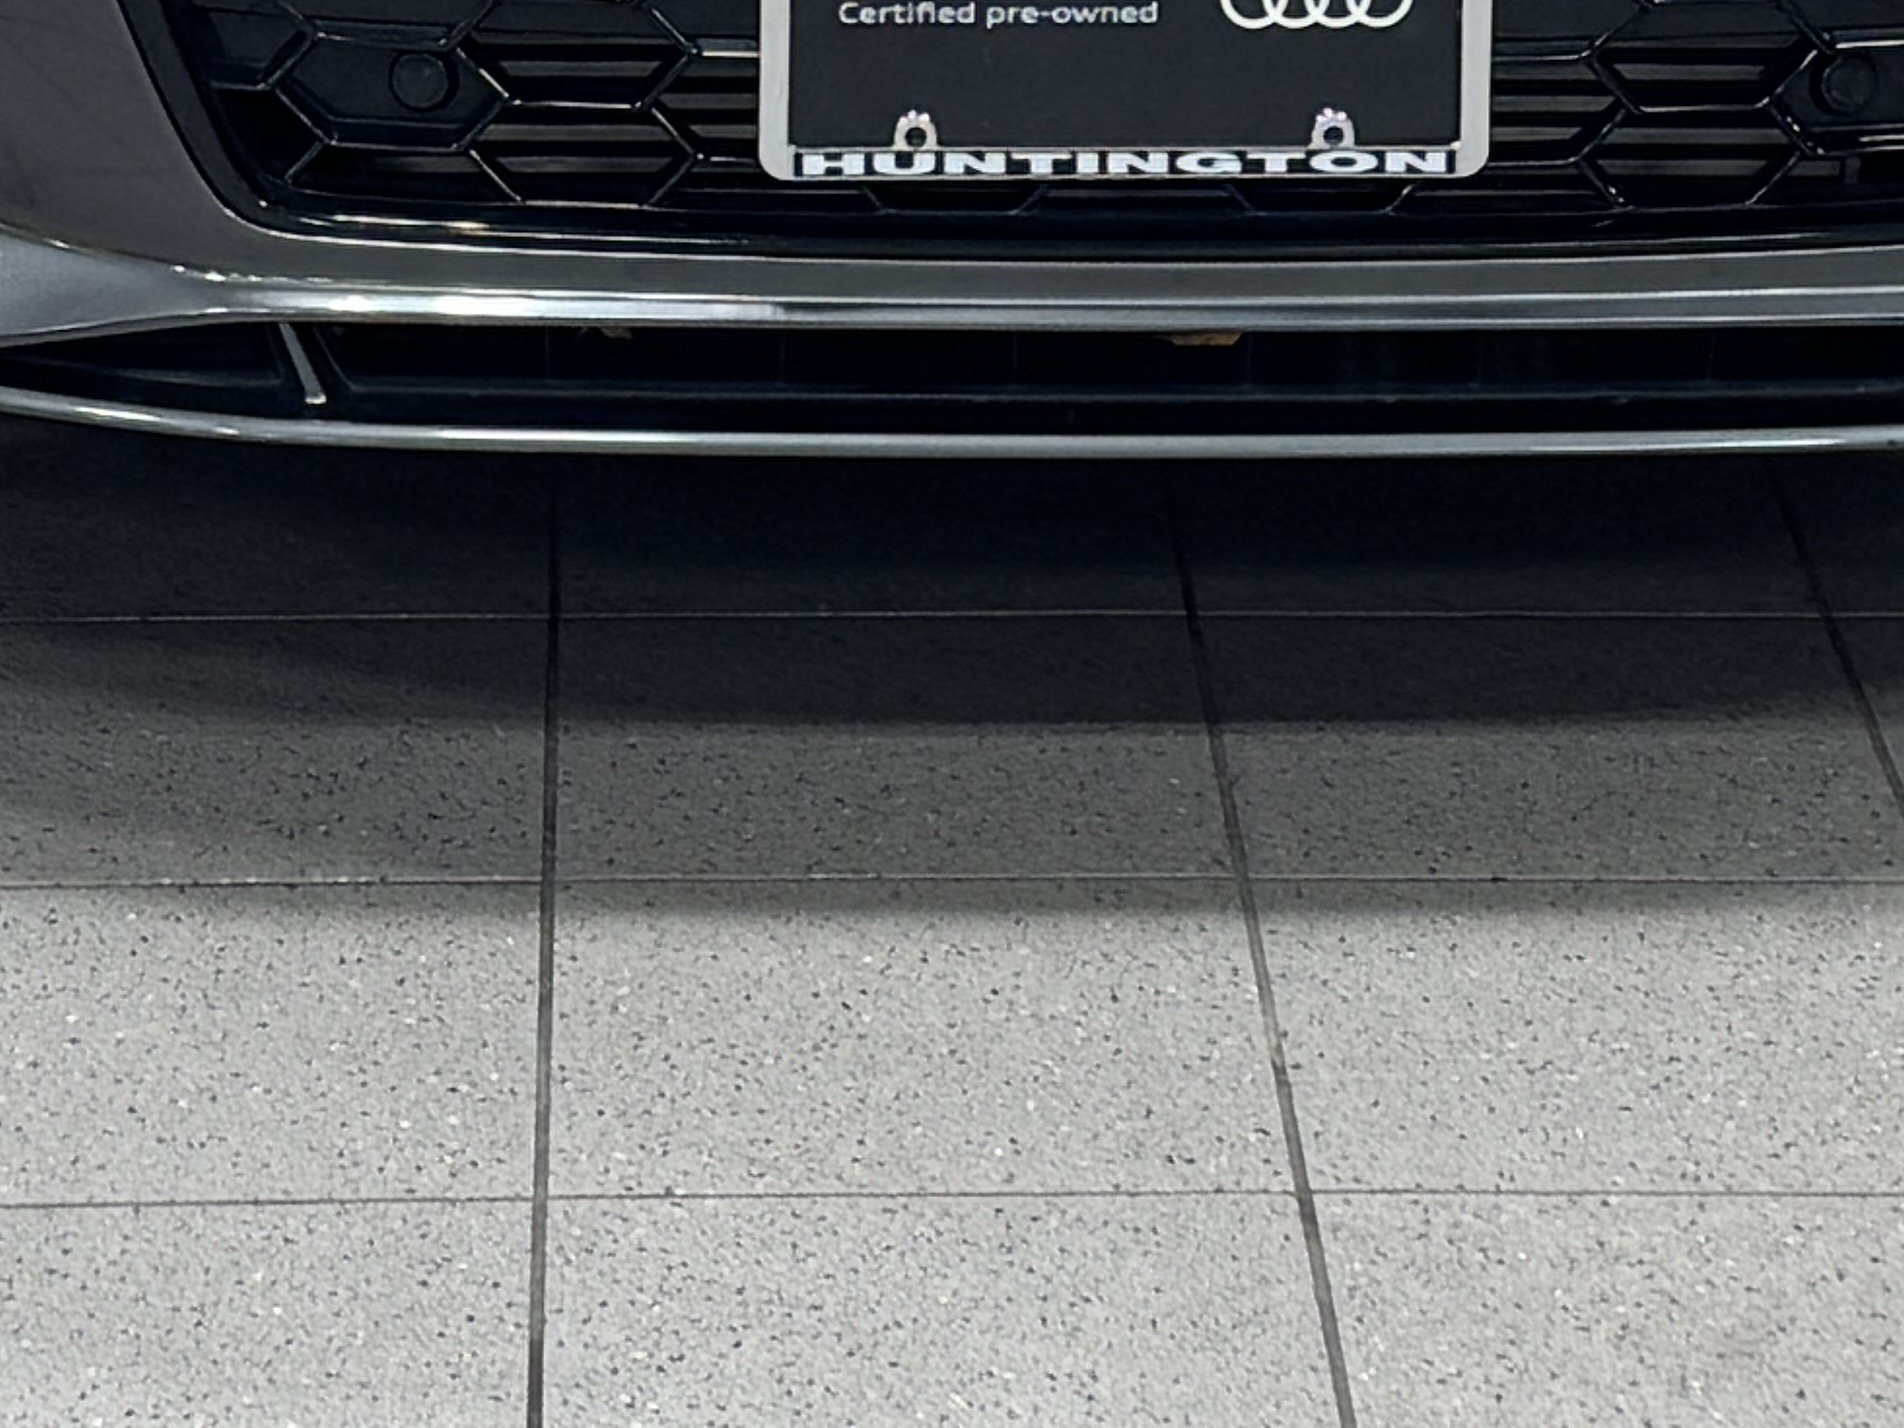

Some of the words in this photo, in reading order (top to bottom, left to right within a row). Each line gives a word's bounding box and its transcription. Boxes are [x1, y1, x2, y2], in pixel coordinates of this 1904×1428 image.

[838, 1, 976, 25] Certified
[986, 1, 1159, 29] pre-owned
[801, 150, 1447, 176] HUNTINGTON
